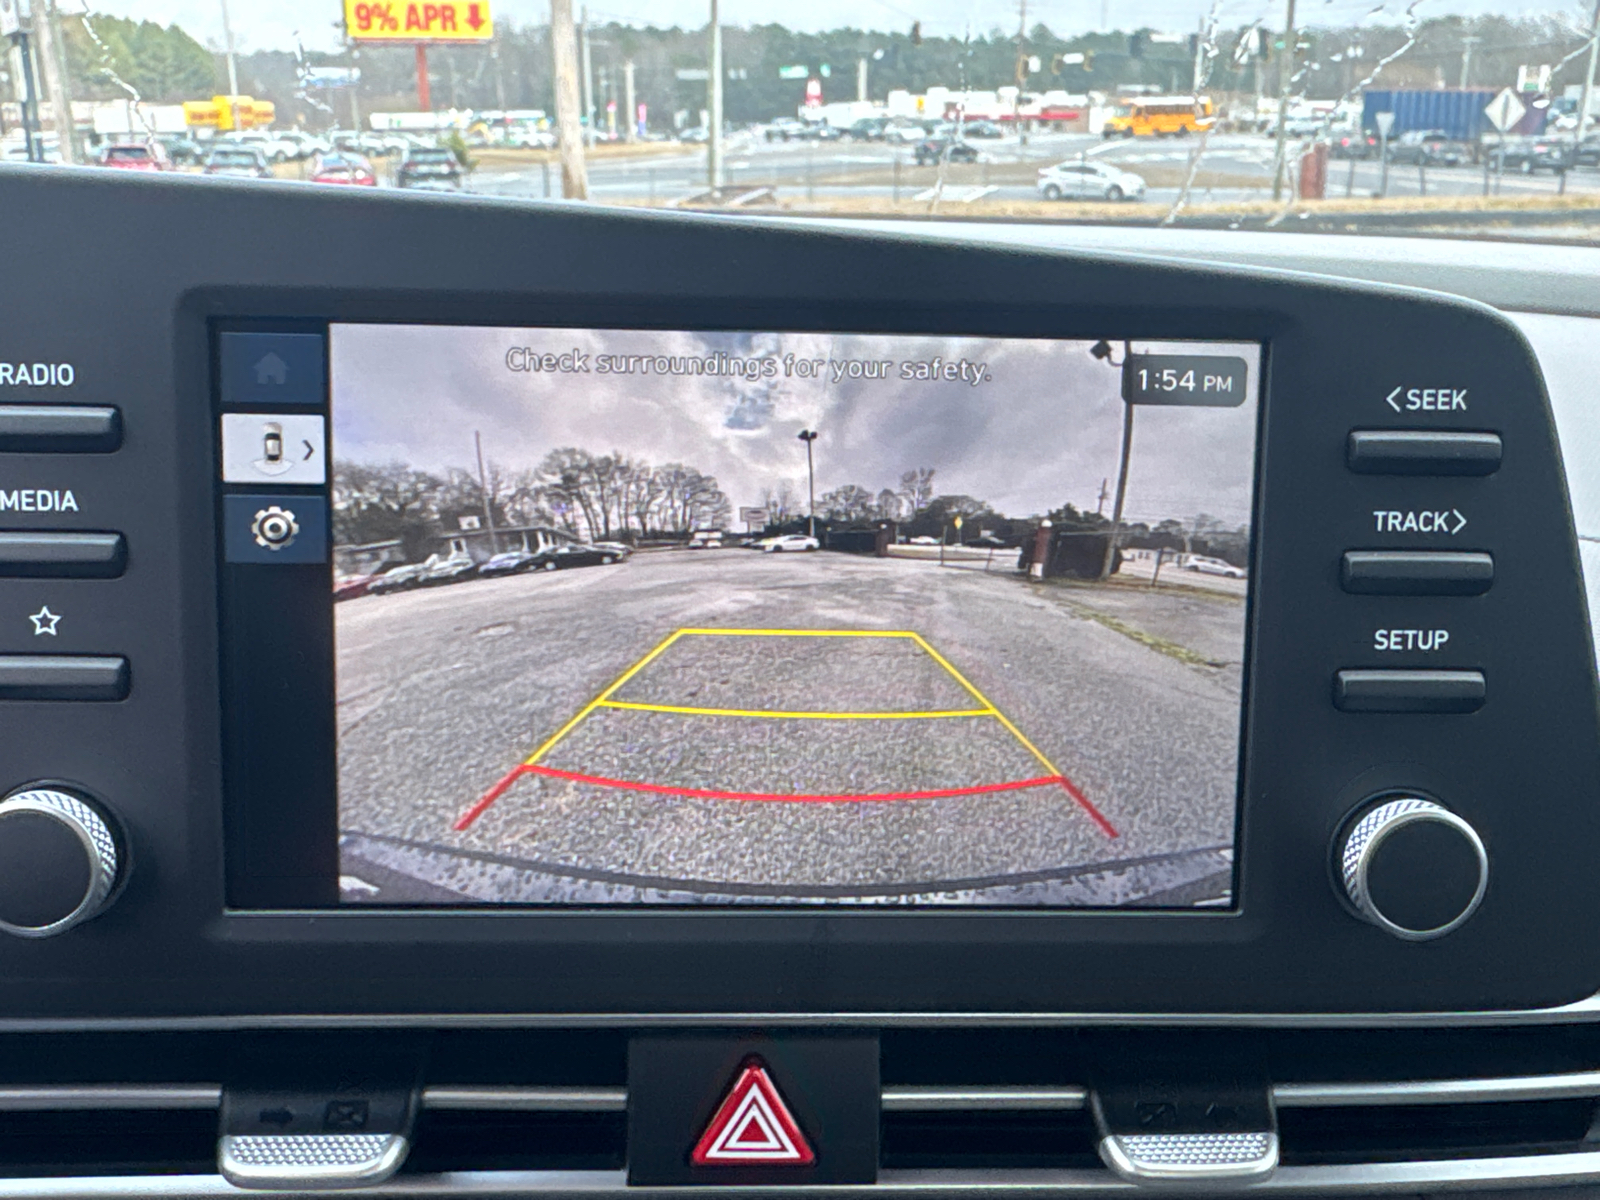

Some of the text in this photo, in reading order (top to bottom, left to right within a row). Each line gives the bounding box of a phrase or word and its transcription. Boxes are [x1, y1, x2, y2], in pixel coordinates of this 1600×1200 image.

[354, 3, 457, 31] 9% APR
[0, 363, 75, 386] RADIO
[505, 347, 993, 386] Check surroundings for your safety.
[1138, 369, 1232, 392] 1:54 PM
[1405, 389, 1468, 411] SEEK
[0, 490, 79, 512] MEDIA
[1373, 511, 1450, 532] TRACK
[1374, 629, 1449, 650] SETUP
